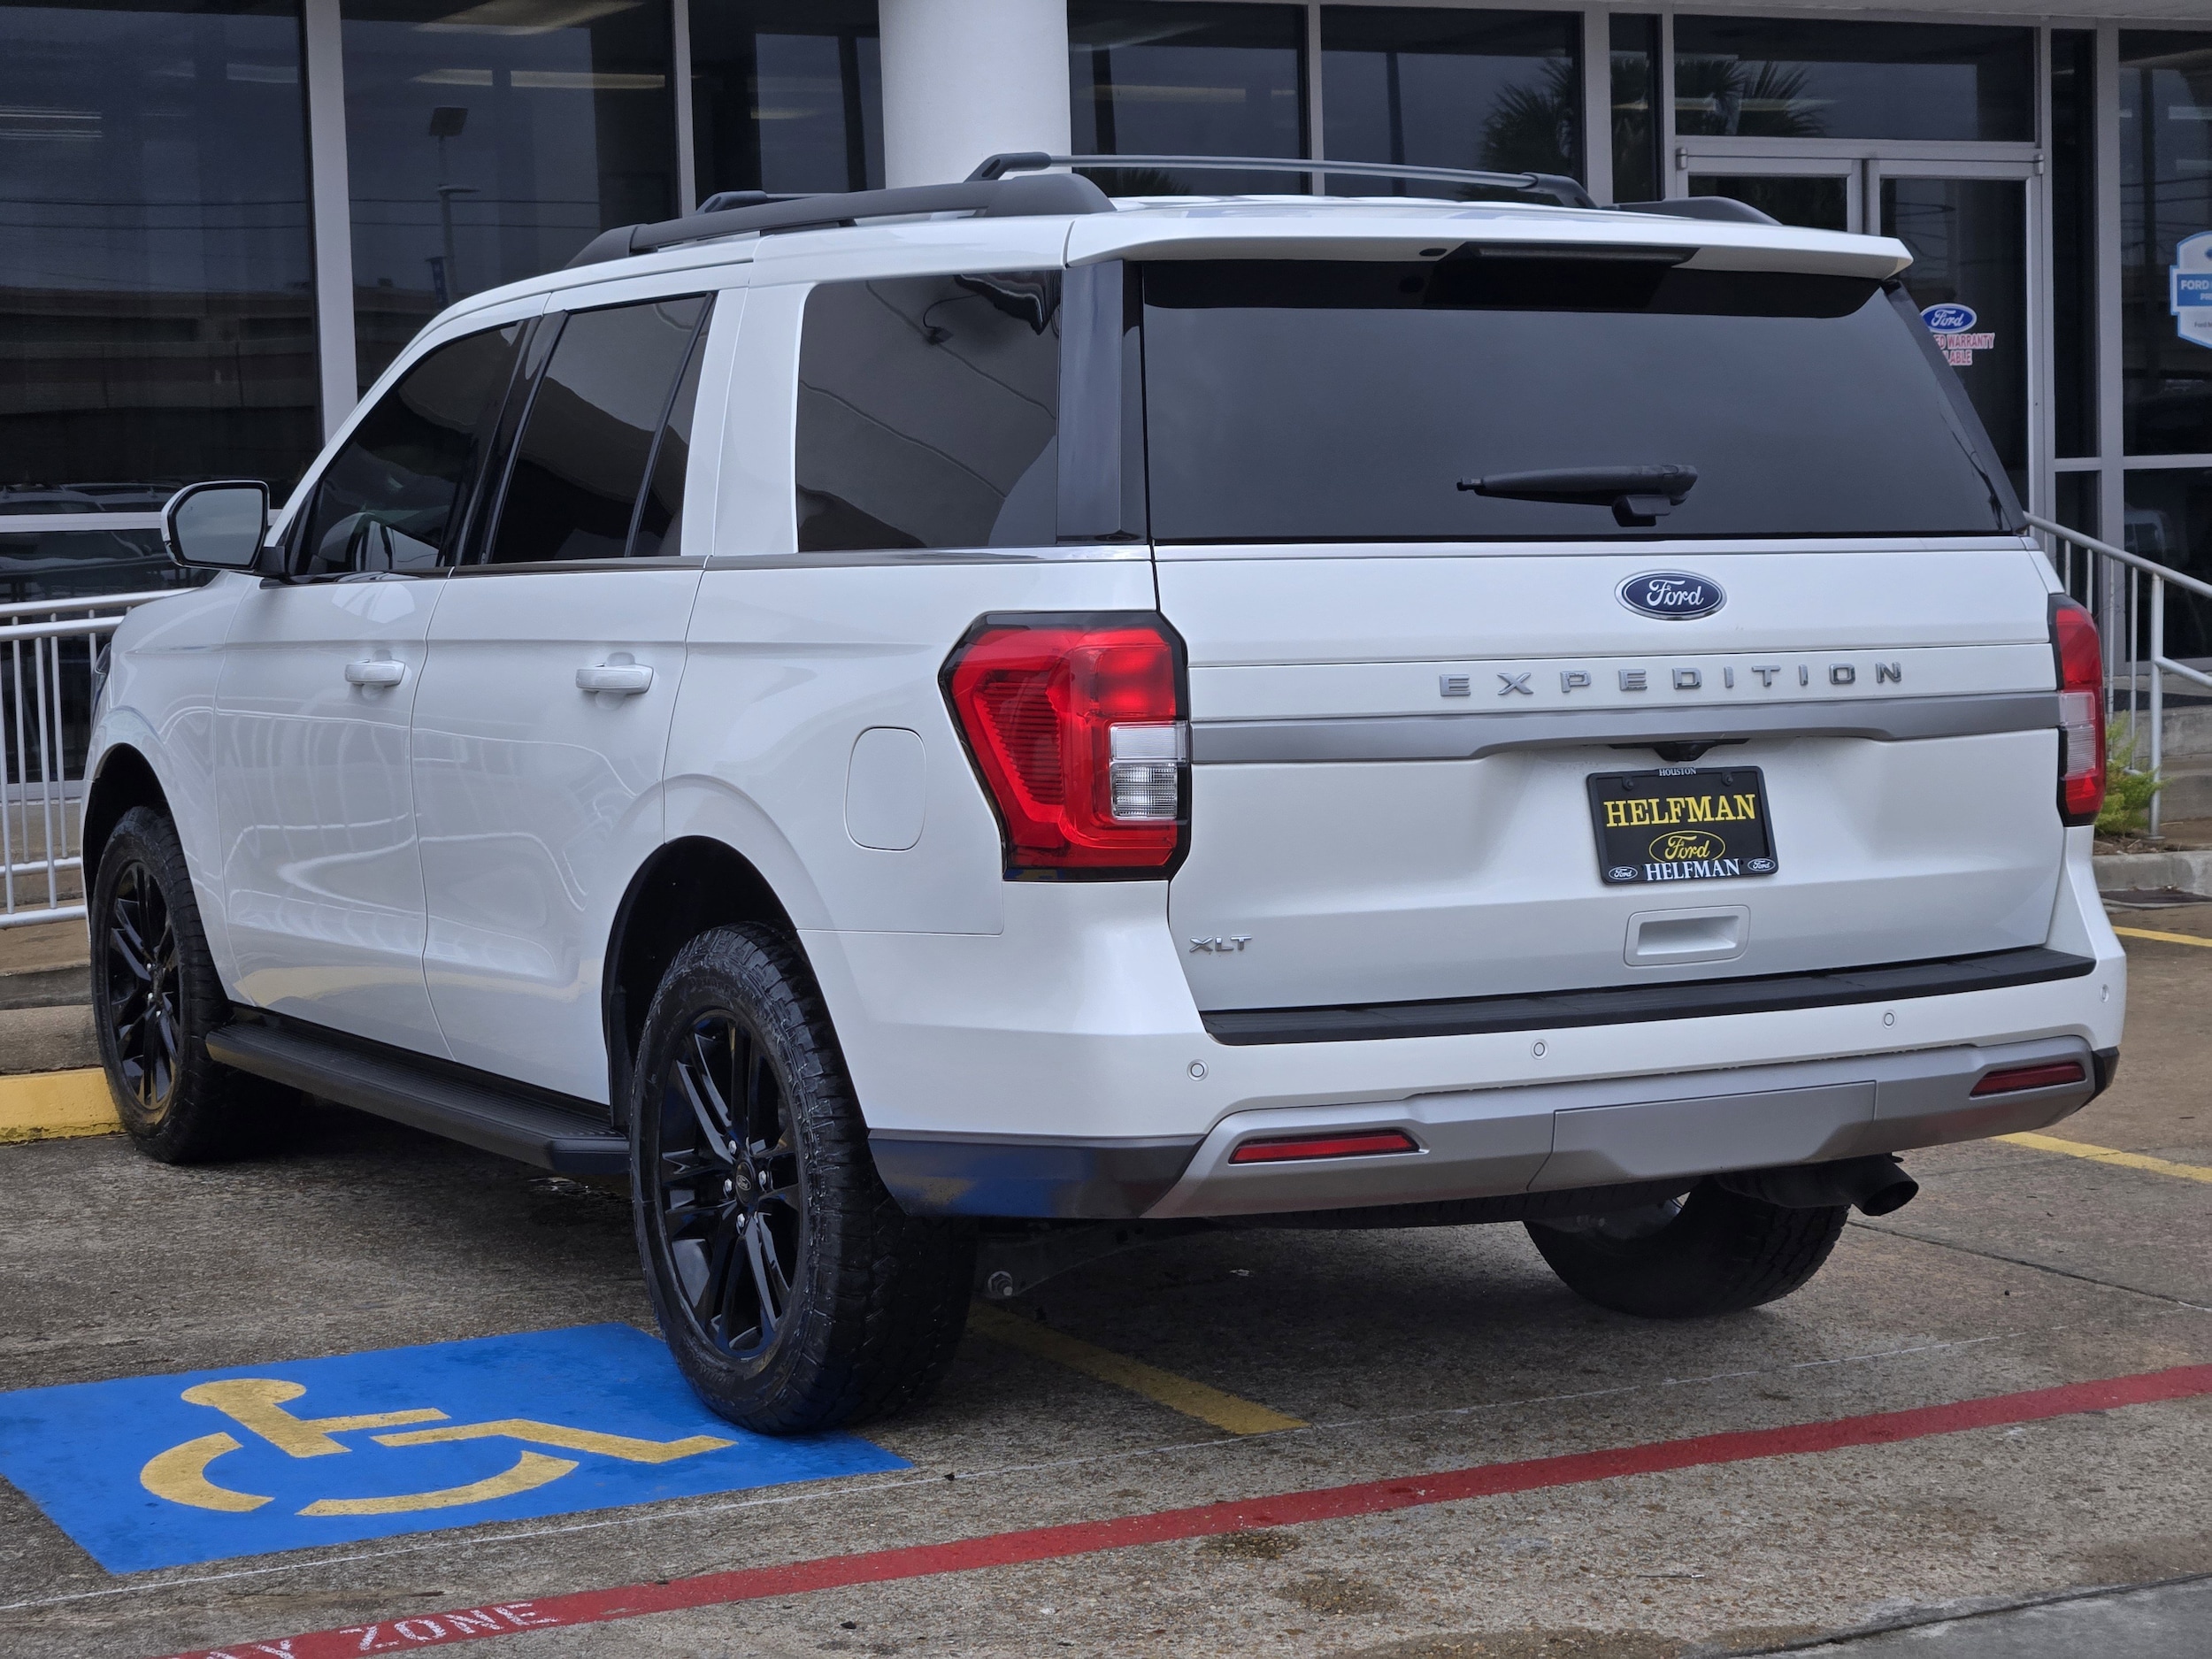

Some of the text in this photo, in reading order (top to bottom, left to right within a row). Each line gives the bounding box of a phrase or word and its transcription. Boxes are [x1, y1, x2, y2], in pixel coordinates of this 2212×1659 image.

[2180, 280, 2209, 290] FORD
[1930, 309, 1964, 326] Ford
[1947, 334, 1994, 349] WARRANTY
[1646, 579, 1704, 607] Ford
[1440, 661, 1902, 697] EXPEDITION
[1658, 767, 1697, 777] HOUSTON
[1603, 794, 1755, 827] HELFMAN
[1664, 835, 1710, 860] Ford
[1613, 867, 1632, 879] Ford
[1645, 858, 1740, 881] HELFMAN
[1189, 935, 1253, 952] XLT
[340, 1602, 561, 1650] ZONE
